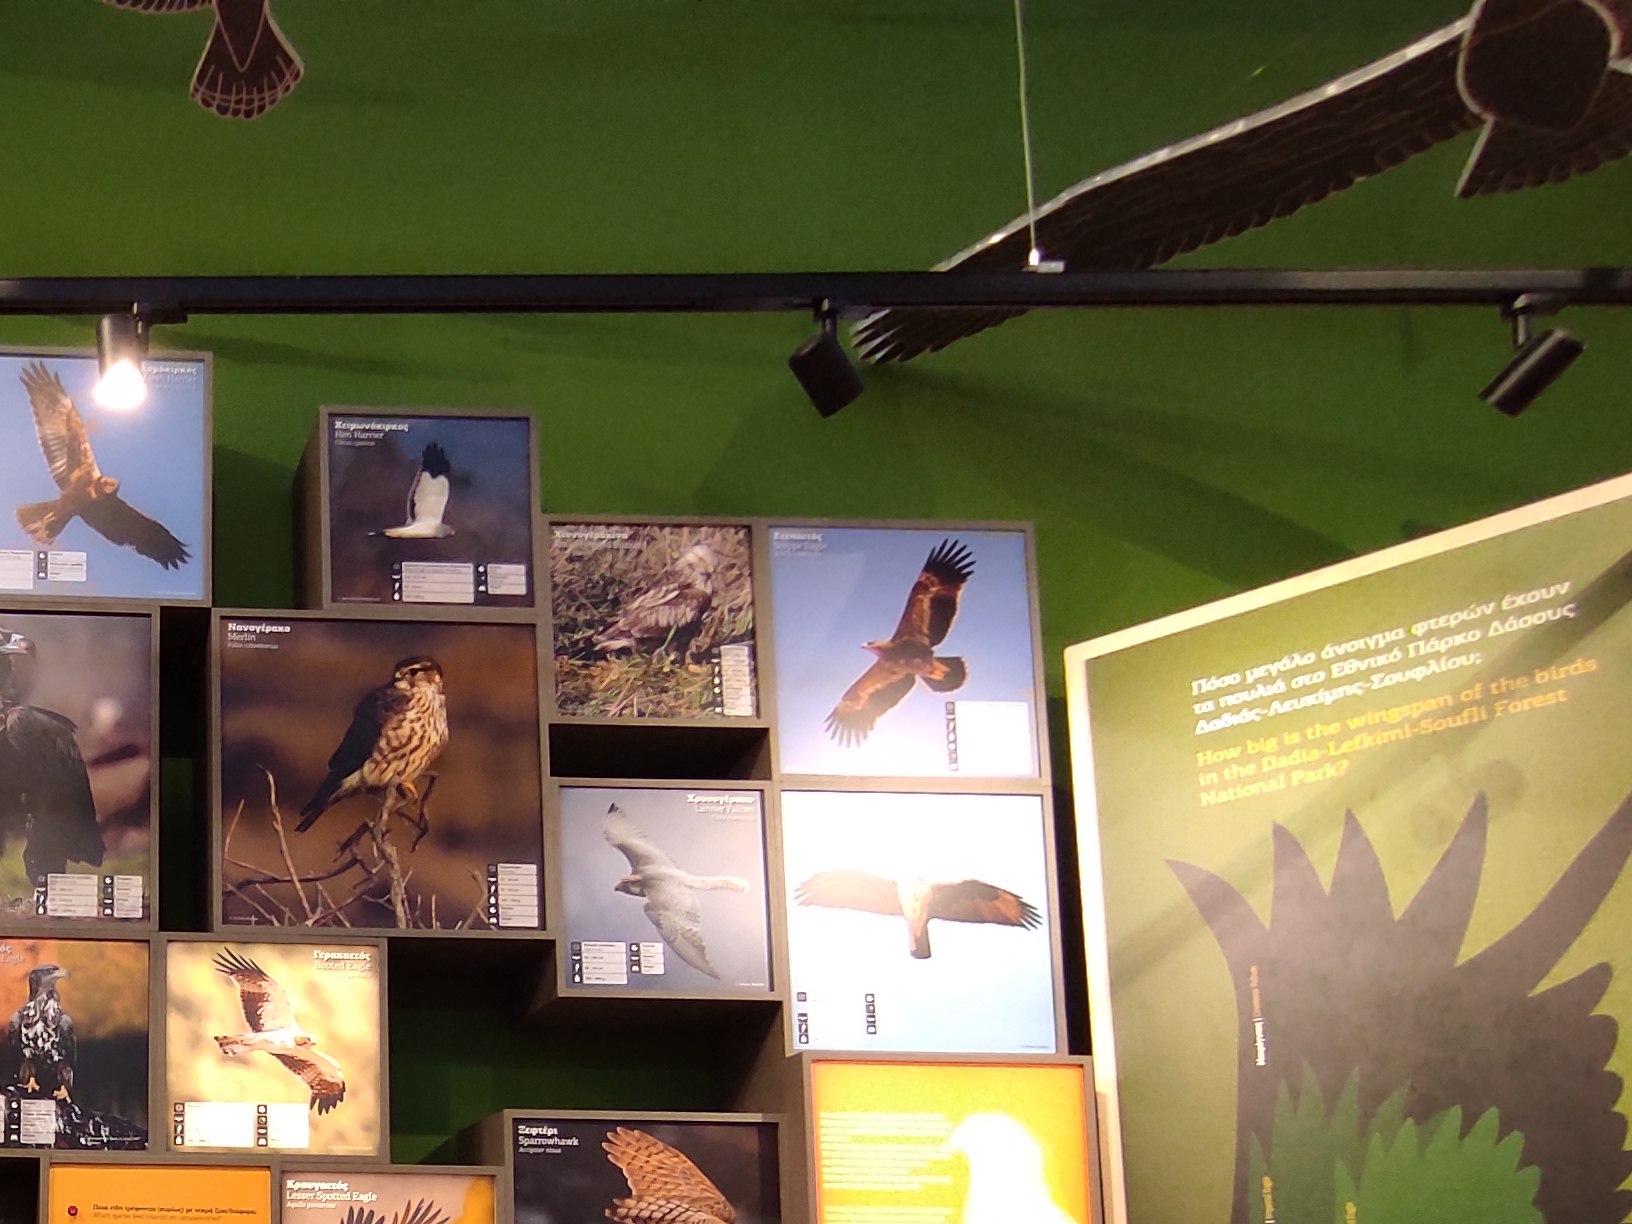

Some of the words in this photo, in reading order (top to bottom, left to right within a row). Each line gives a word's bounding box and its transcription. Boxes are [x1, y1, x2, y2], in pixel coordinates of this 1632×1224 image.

[1191, 672, 1242, 696] Πόσο
[1245, 651, 1317, 686] μεγάλο
[1321, 628, 1405, 660] άνοιγμα
[1410, 602, 1497, 637] φτερών
[1501, 580, 1572, 611] έχουν
[1330, 650, 1403, 679] Εθνικό
[1407, 630, 1482, 659] Πάρκο
[1488, 602, 1577, 637] Δάσους
[1196, 746, 1242, 767] How
[1460, 682, 1485, 702] of
[1489, 674, 1529, 696] the
[1533, 658, 1599, 685] birds
[1200, 774, 1287, 807] National
[518, 1136, 579, 1147] Sparrowhawk
